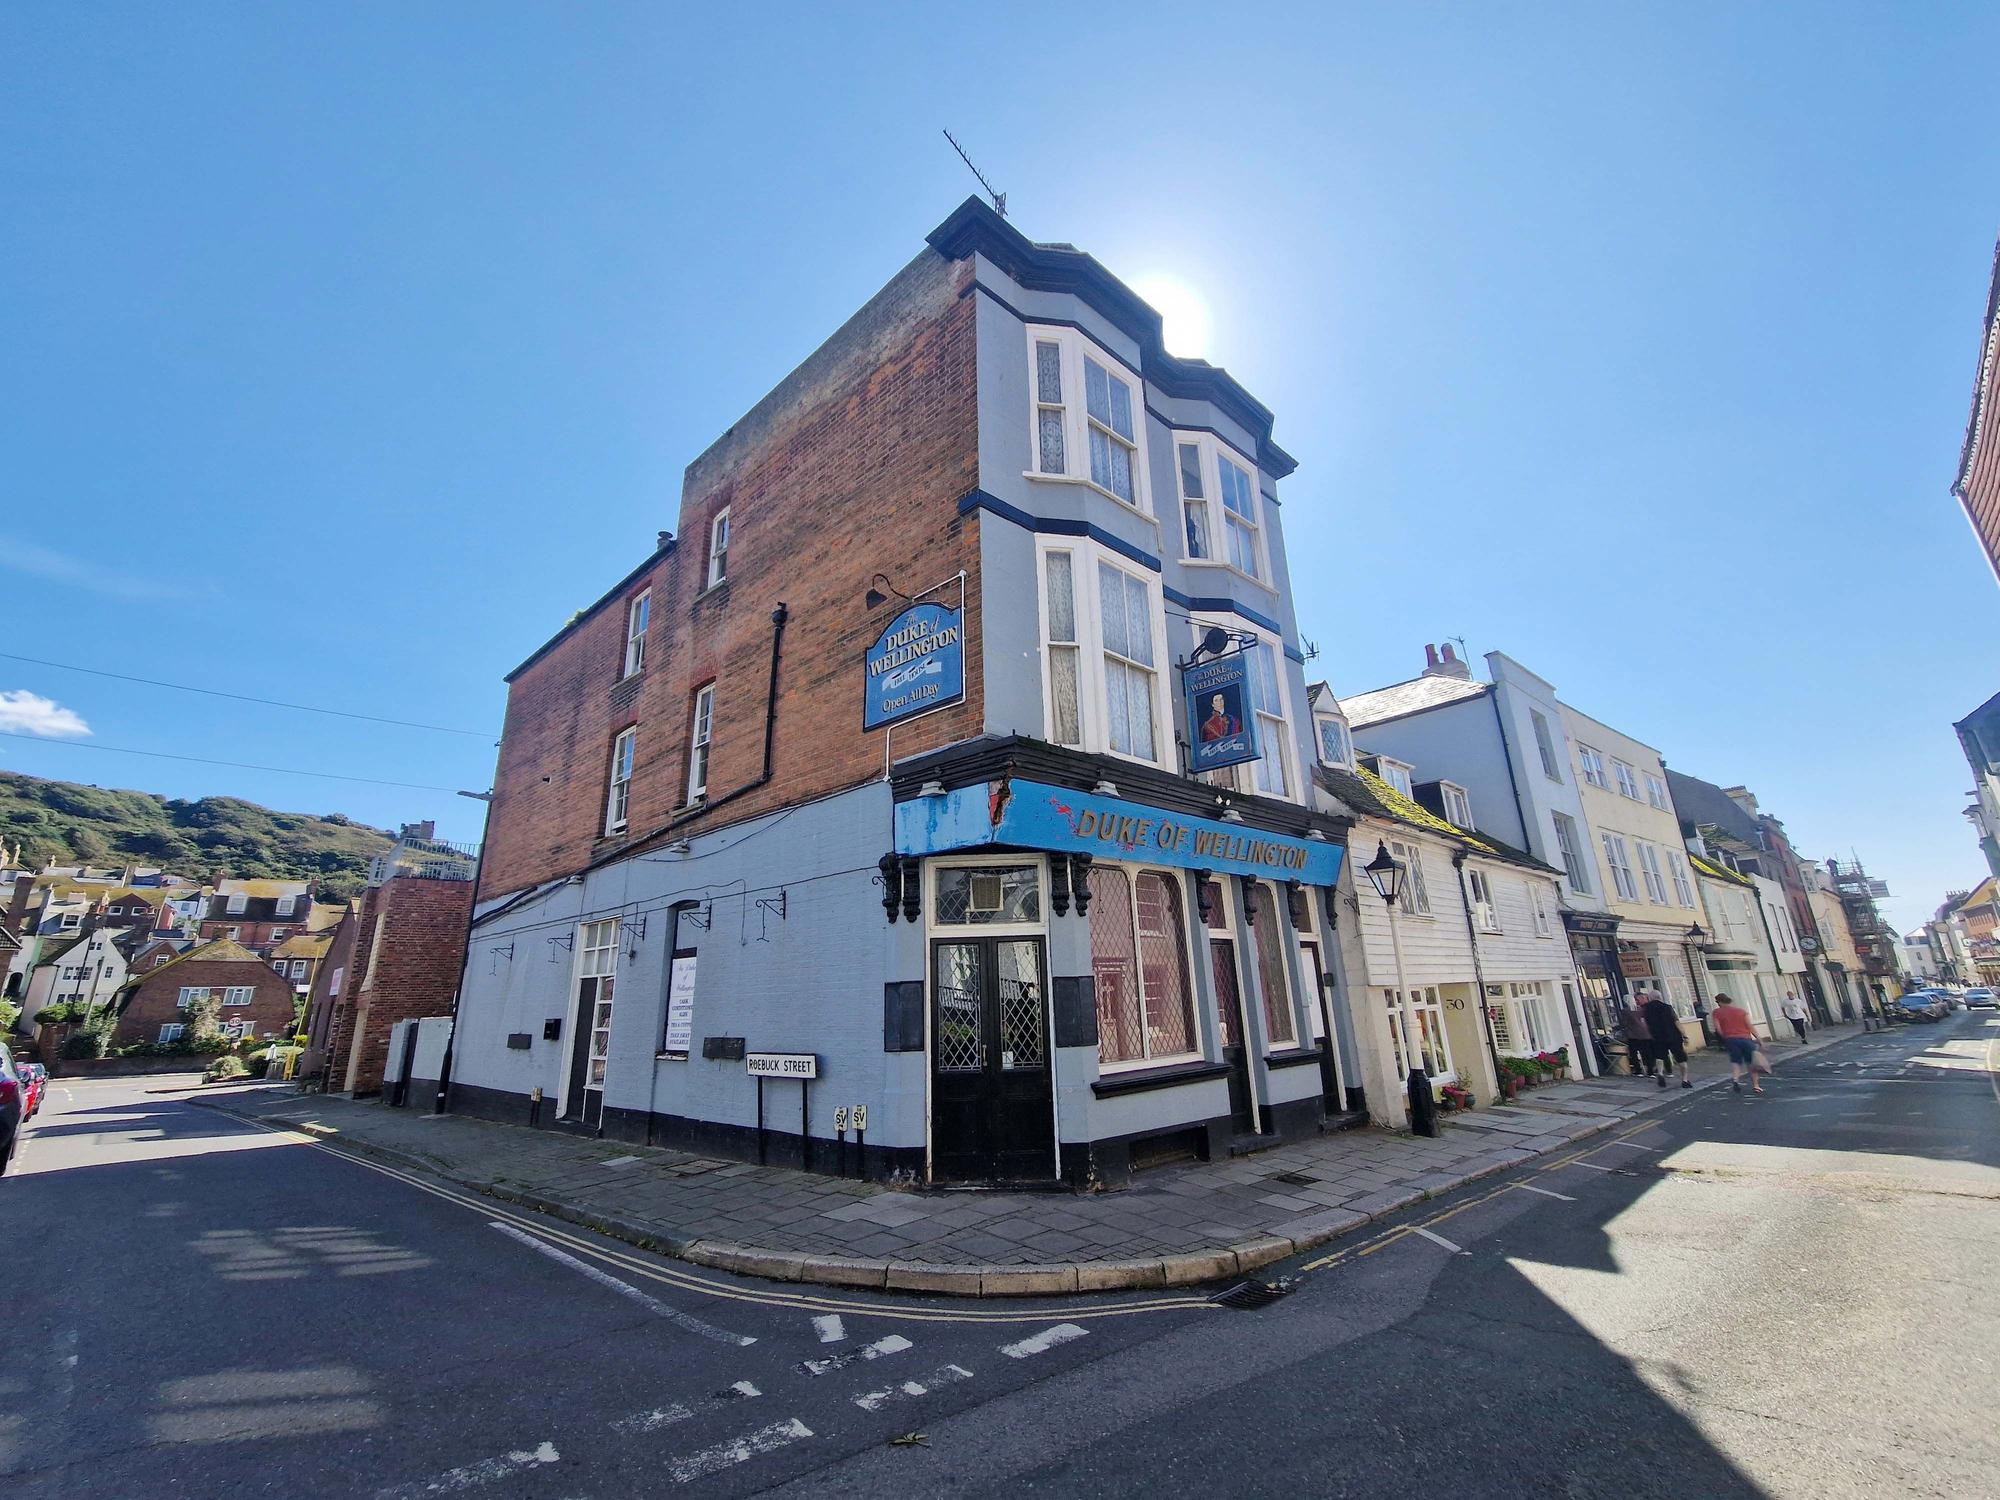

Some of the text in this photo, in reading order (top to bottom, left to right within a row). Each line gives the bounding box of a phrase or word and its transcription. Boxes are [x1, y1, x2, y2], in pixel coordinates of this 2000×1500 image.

[885, 614, 941, 653] DUKE of
[869, 625, 958, 677] WELLINGTON
[1203, 664, 1227, 679] DUKE
[1190, 670, 1243, 692] WELLINGTON
[882, 683, 939, 713] Open All Day
[1077, 808, 1309, 870] DUKE OF WELLINGTON
[1446, 999, 1465, 1010] 30
[748, 1058, 812, 1073] ROEBUCK STREET
[835, 1113, 847, 1124] SV
[853, 1111, 865, 1122] SV
